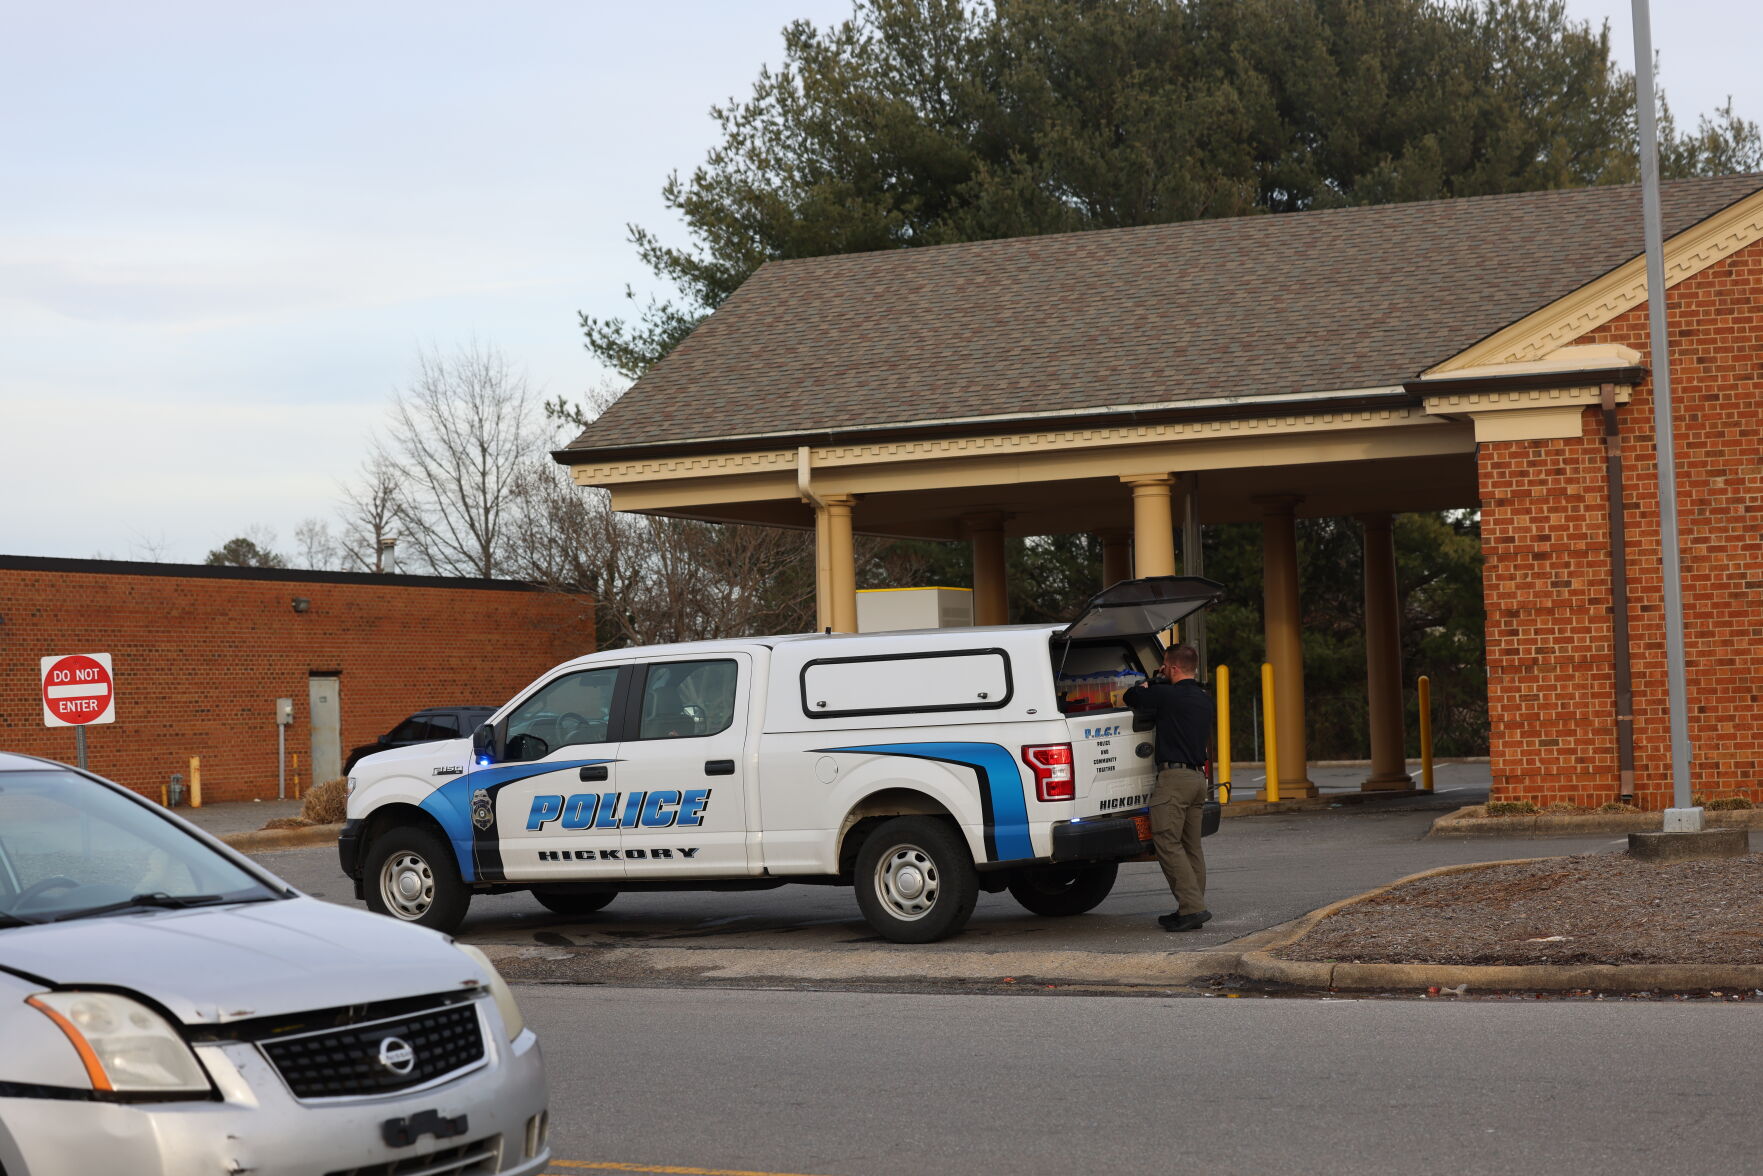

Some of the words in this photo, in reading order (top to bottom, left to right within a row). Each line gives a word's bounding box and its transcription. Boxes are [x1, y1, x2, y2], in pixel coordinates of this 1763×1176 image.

[53, 670, 71, 682] DO
[76, 668, 100, 681] NOT
[59, 699, 99, 713] ENTER
[1093, 756, 1117, 765] COMMUNITY
[1096, 765, 1116, 774] TOGETHER
[1099, 793, 1153, 811] HICKORY
[525, 788, 713, 832] POLICE
[537, 847, 701, 862] HICKORY
